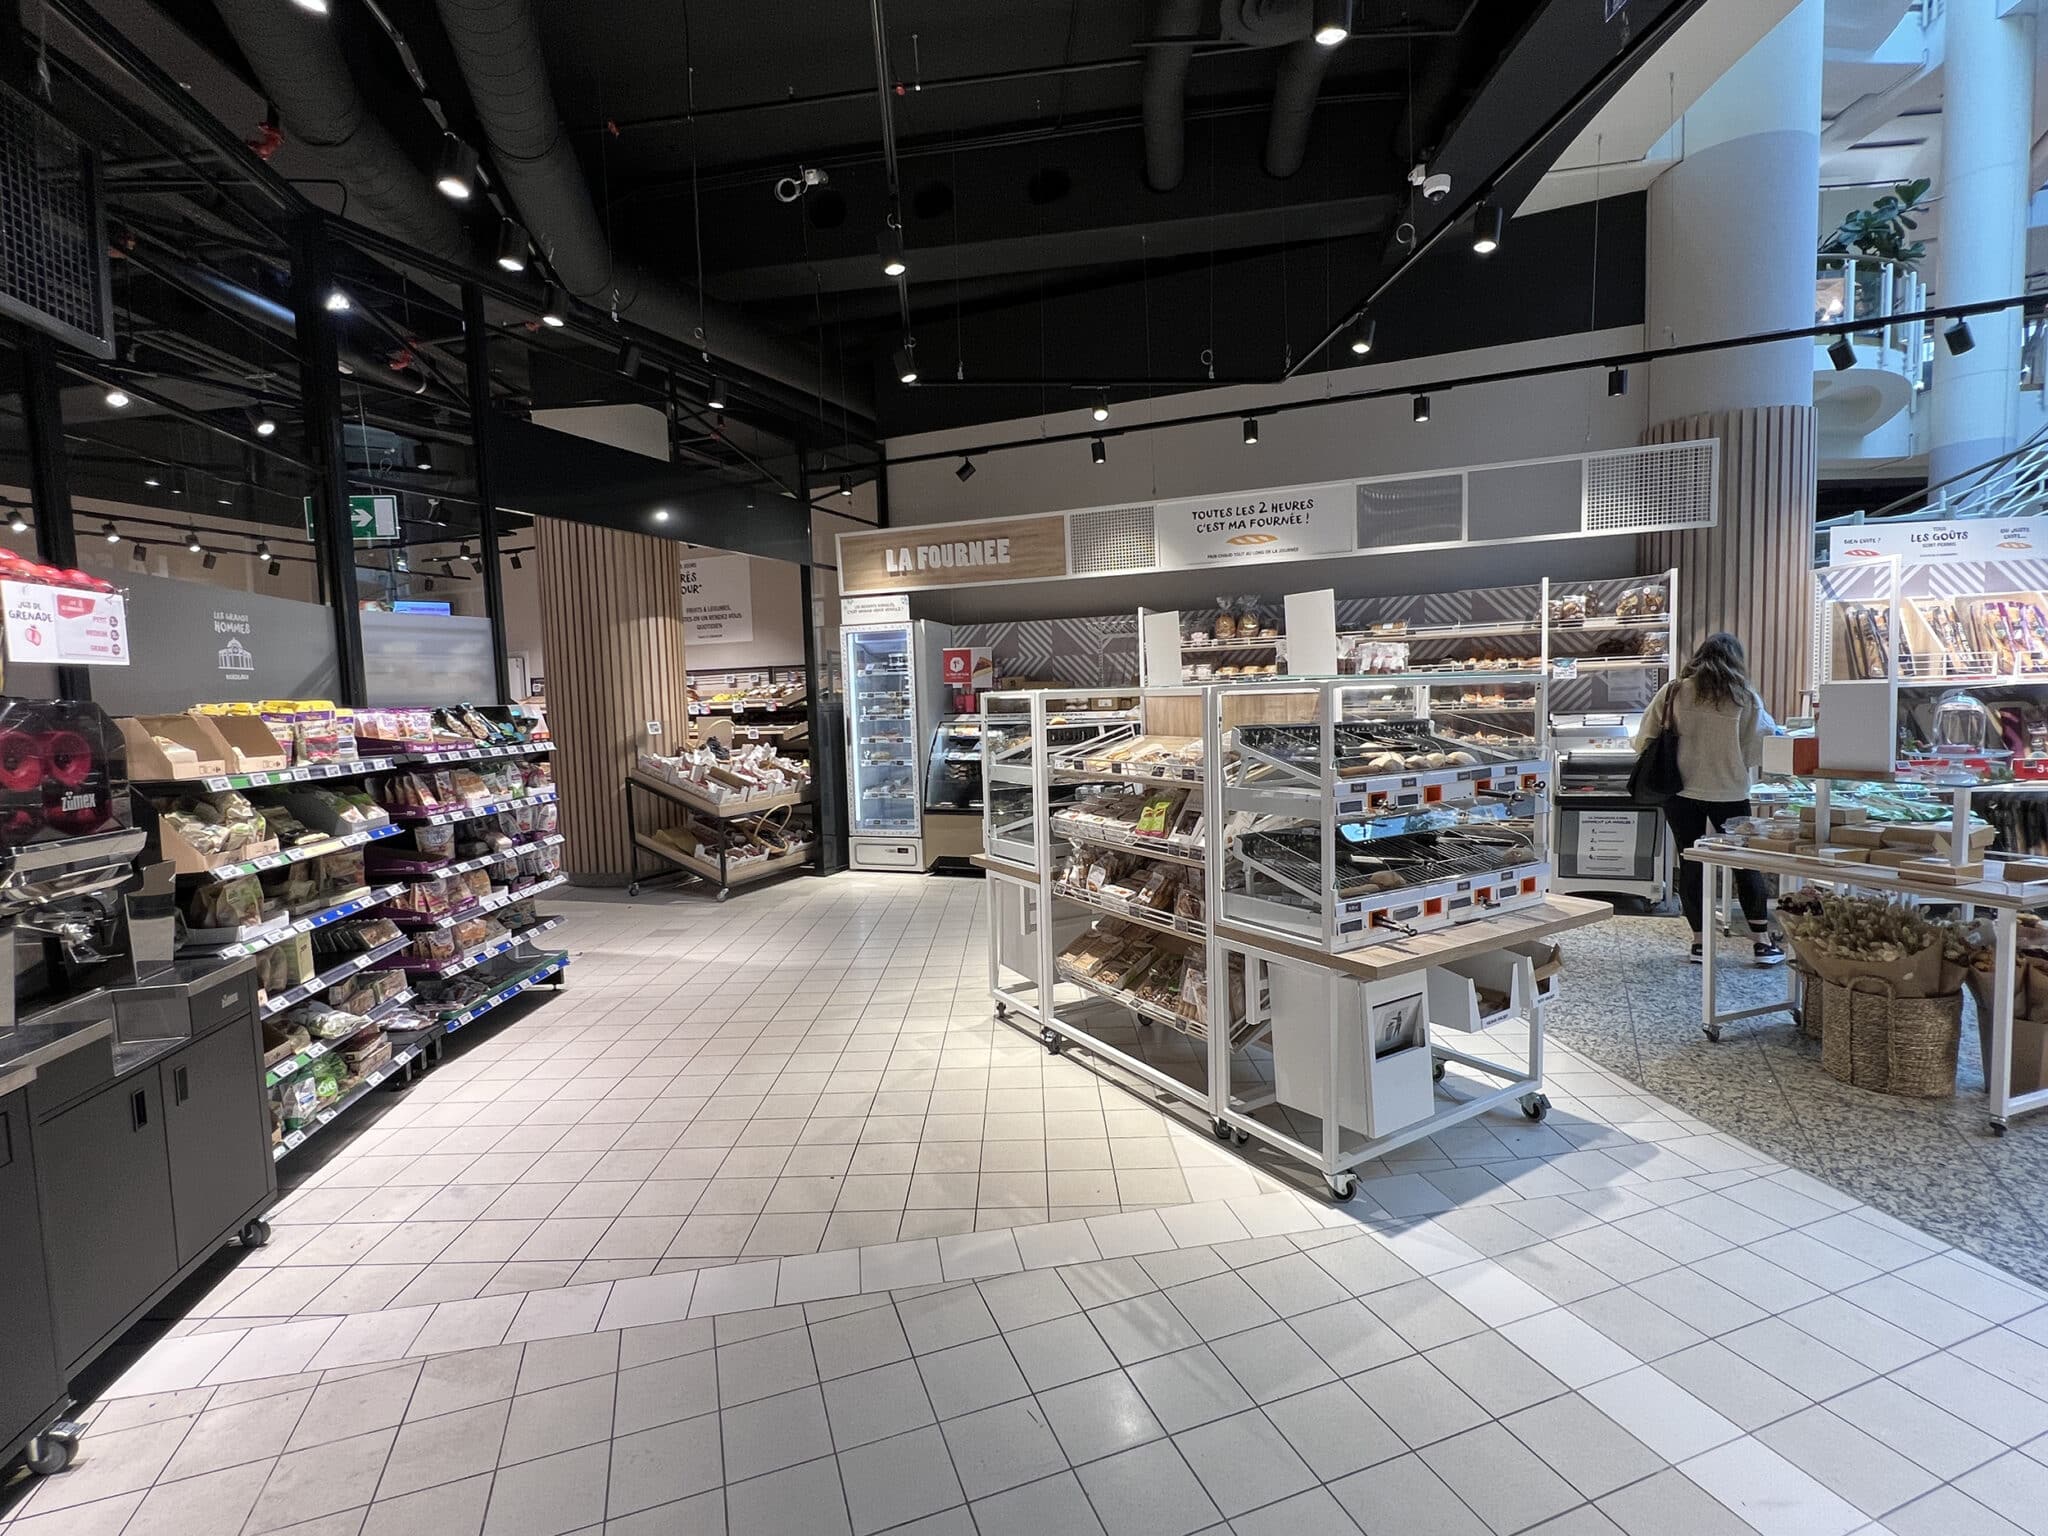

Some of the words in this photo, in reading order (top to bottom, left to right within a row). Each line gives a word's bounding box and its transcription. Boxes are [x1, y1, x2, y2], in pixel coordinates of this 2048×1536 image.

[1192, 507, 1233, 520] TOUTES
[1236, 505, 1255, 517] LES
[1259, 501, 1268, 514] 2
[1271, 498, 1314, 513] HEURES
[1197, 522, 1225, 534] C'EST
[1228, 520, 1246, 530] MA
[1250, 513, 1302, 528] FOURNÉE
[1911, 533, 1929, 543] LES
[1932, 529, 1969, 541] GOÛTS
[885, 547, 913, 572] LA
[917, 538, 1010, 570] FOURNEE
[680, 571, 697, 583] RÉS
[681, 584, 702, 595] OUR
[8, 610, 53, 622] GRENADE
[214, 620, 251, 634] HOMMES
